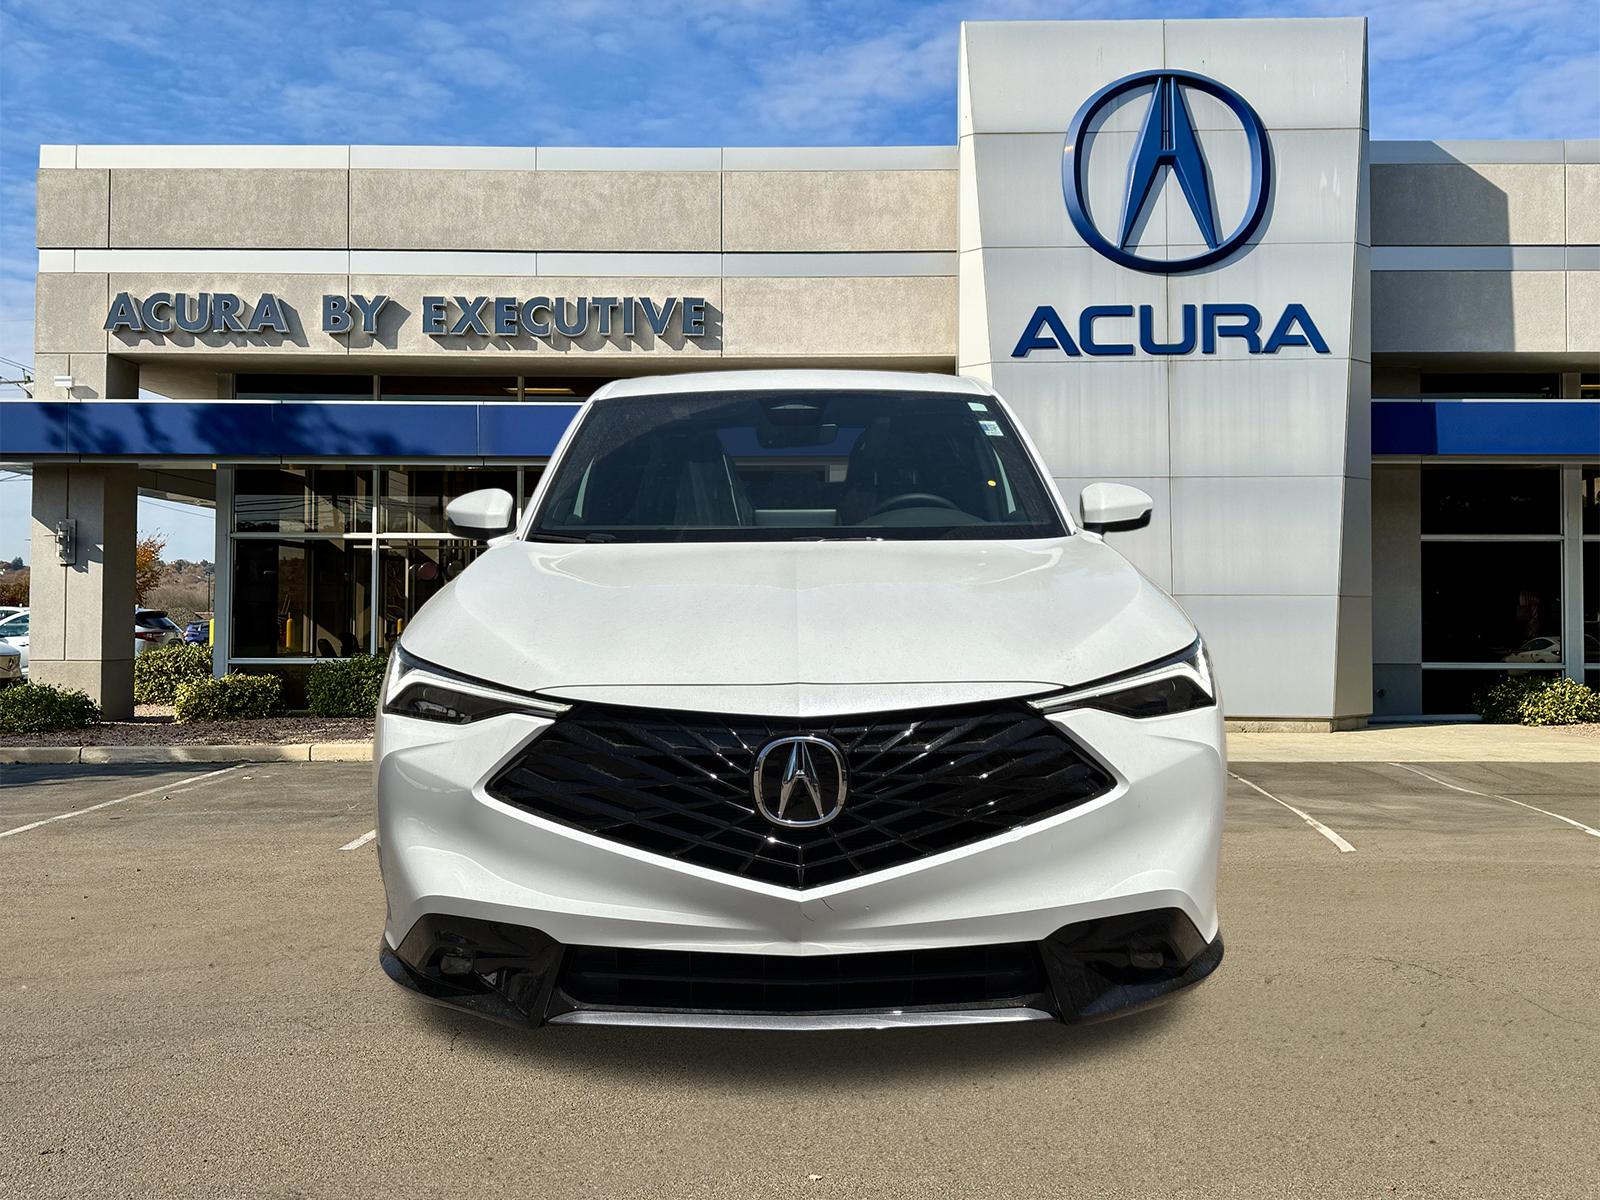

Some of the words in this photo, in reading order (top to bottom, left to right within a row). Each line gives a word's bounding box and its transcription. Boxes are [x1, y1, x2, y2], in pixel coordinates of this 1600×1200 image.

[104, 292, 290, 333] ACURA
[322, 294, 391, 335] BY
[423, 296, 707, 338] EXECUTIVE
[1011, 303, 1332, 357] ACURA
